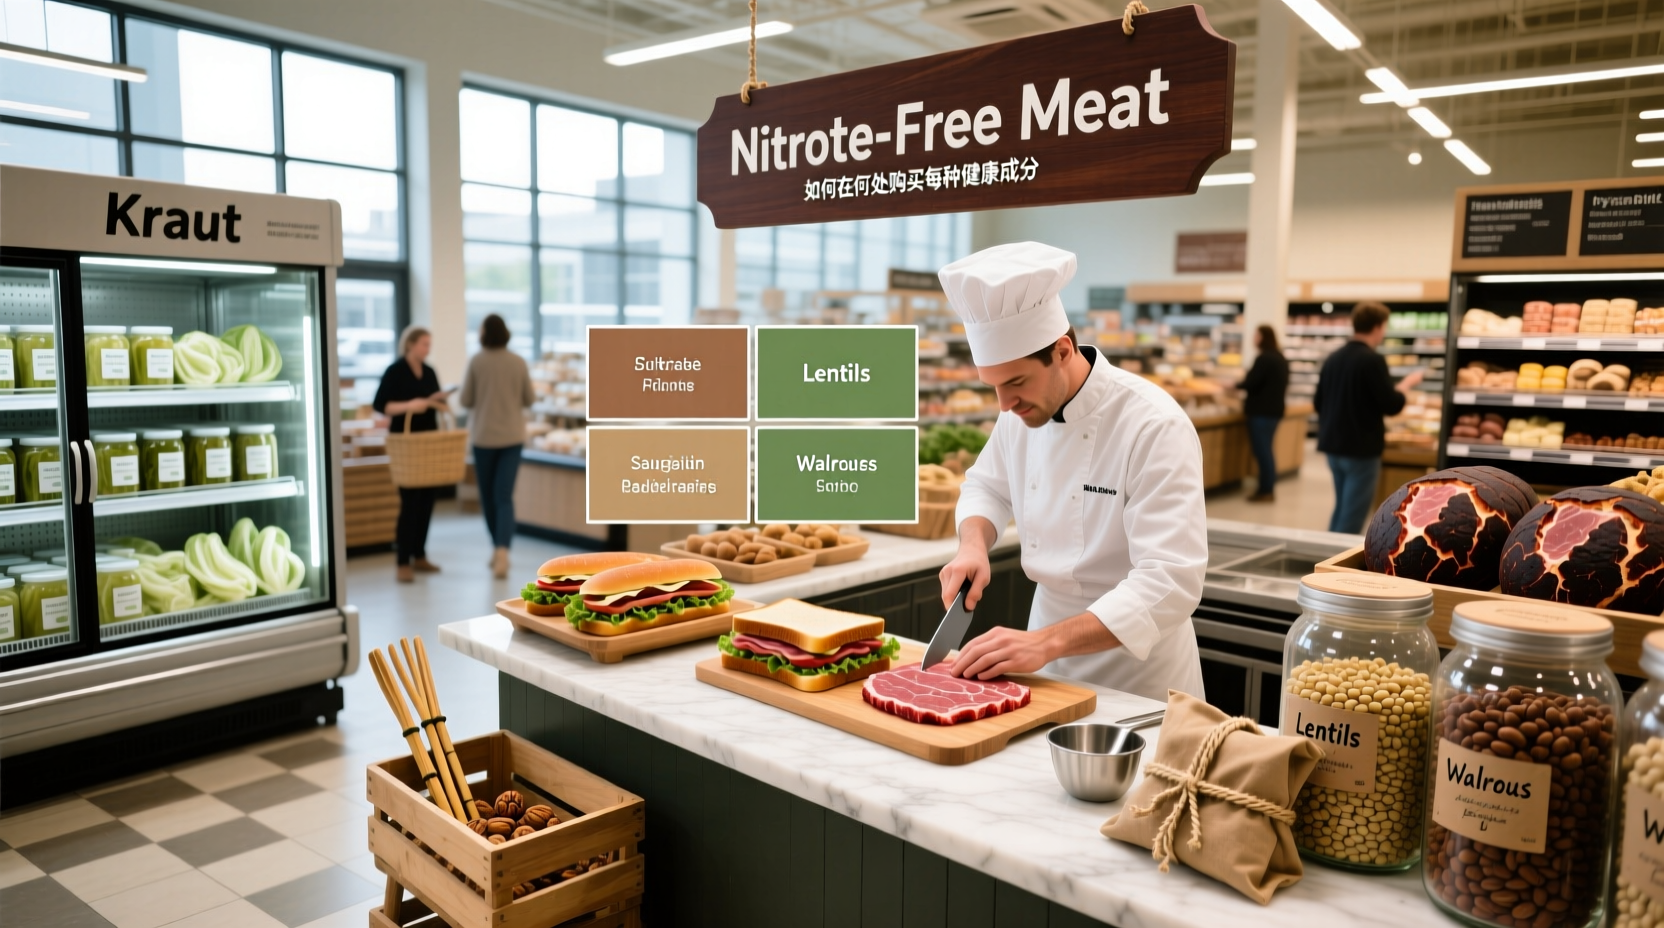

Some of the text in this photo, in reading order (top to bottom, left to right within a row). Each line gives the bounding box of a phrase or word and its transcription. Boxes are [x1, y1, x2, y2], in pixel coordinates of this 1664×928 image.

[730, 68, 1170, 177] Nitrote-Free Meat
[804, 156, 1040, 201] 如何在何处购买每种健康成分
[106, 192, 242, 243] Kraut
[1296, 711, 1361, 748] Lentils
[1447, 757, 1532, 799] Walrous
